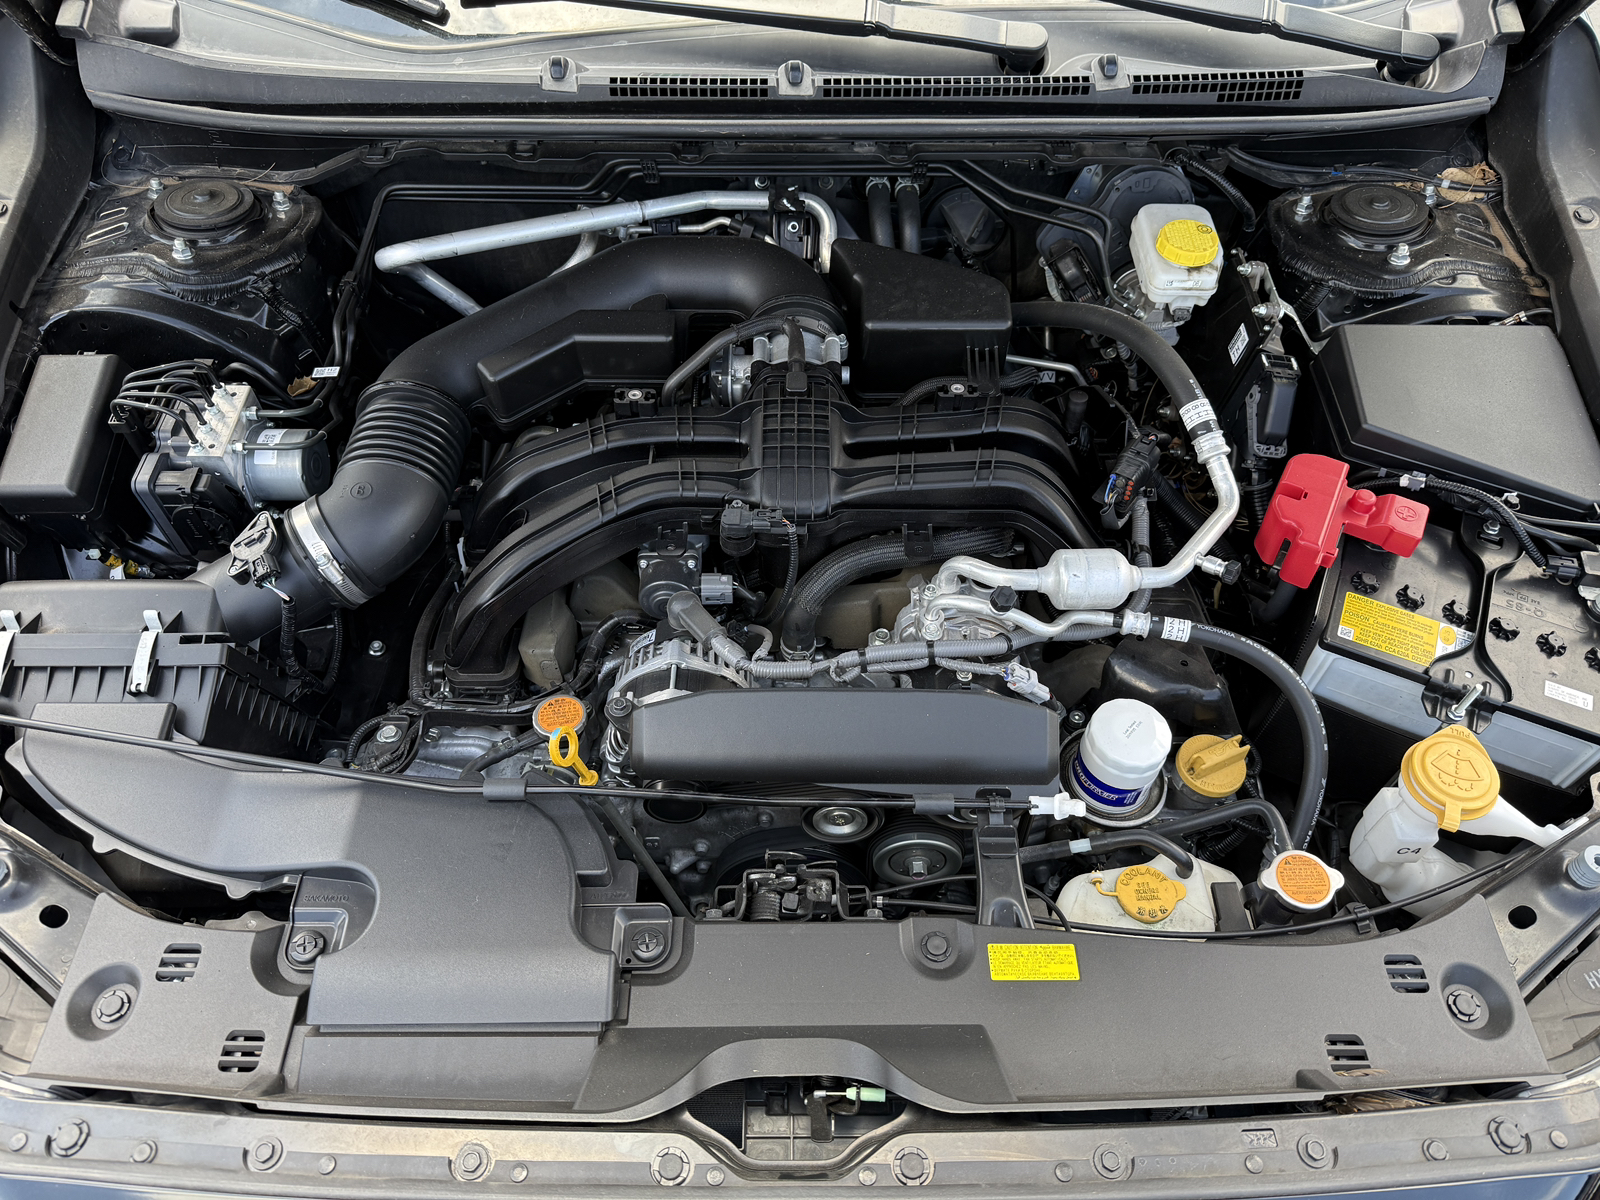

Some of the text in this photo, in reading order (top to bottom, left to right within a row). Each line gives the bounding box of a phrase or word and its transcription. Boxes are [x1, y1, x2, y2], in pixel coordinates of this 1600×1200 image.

[1348, 592, 1374, 606] DANGER
[1344, 610, 1370, 622] POISON
[1196, 623, 1236, 639] YOKOHAMA
[1384, 645, 1396, 653] CCA
[1311, 788, 1325, 826] YOKOHAMA
[1120, 868, 1168, 886] COOLANT
[304, 894, 350, 902] SAKAMOTO
